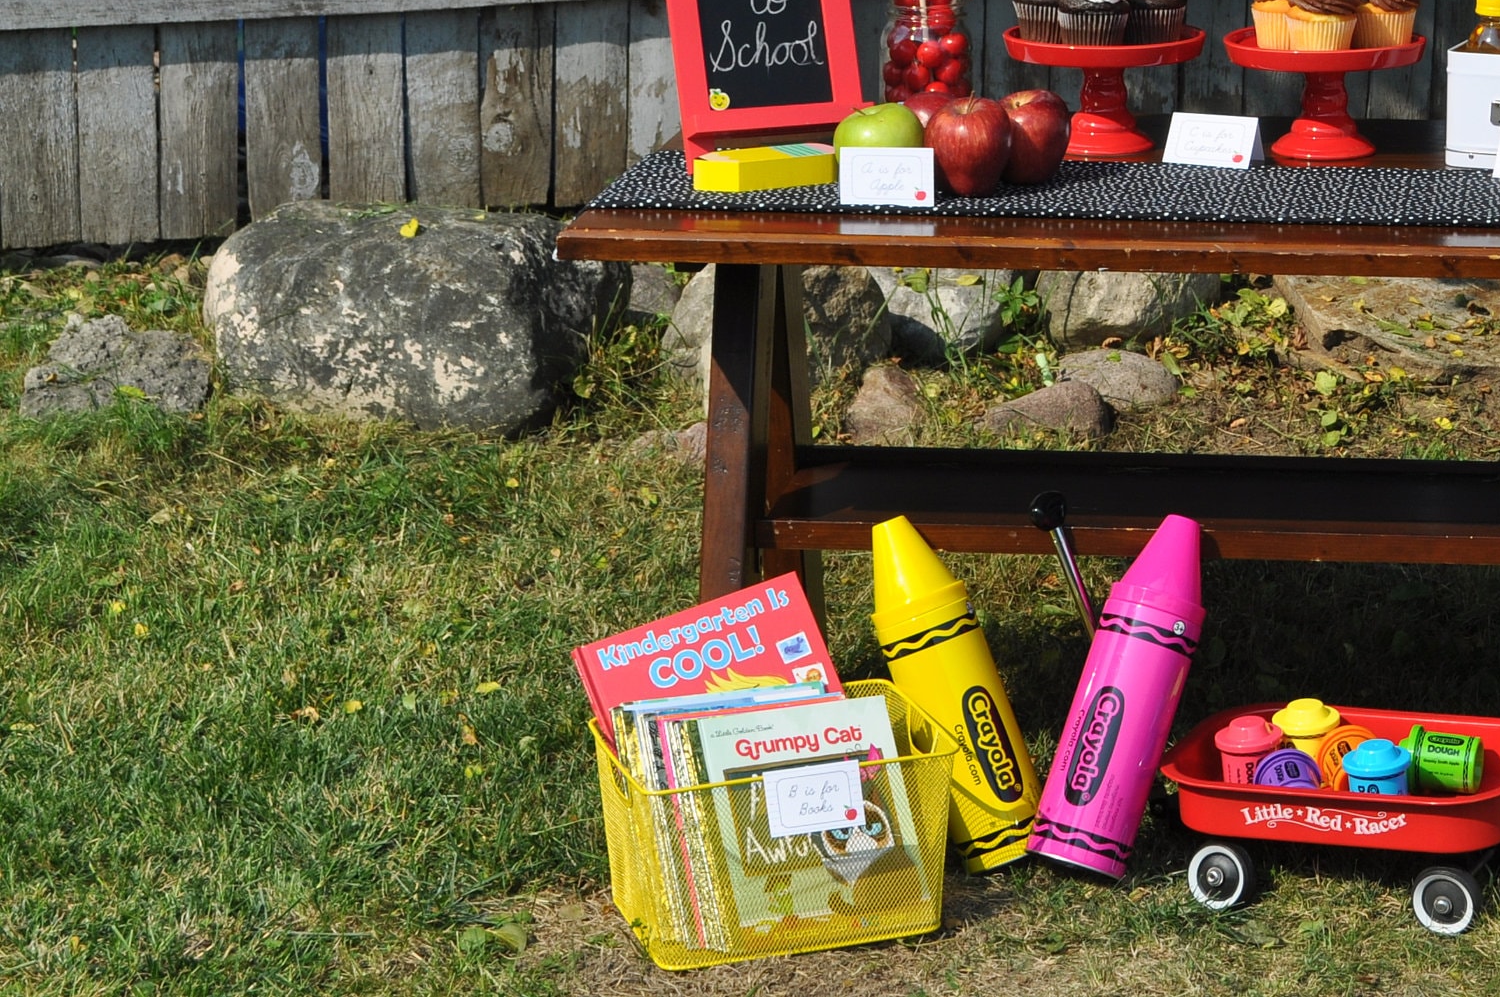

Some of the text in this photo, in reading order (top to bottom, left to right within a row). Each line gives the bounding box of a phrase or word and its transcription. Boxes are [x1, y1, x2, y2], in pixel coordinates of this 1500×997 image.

[709, 19, 824, 73] School
[596, 587, 790, 671] Kindergarten Is
[648, 625, 765, 688] COOL!
[735, 725, 863, 760] Grumpy Cat
[954, 724, 981, 786] Crayola.com
[968, 691, 1015, 790] Crayola
[1071, 693, 1120, 791] Crayola
[1427, 744, 1460, 756] DOUGH
[788, 780, 839, 800] B is for
[799, 799, 833, 816] Books
[1240, 803, 1407, 835] Little Red Racer
